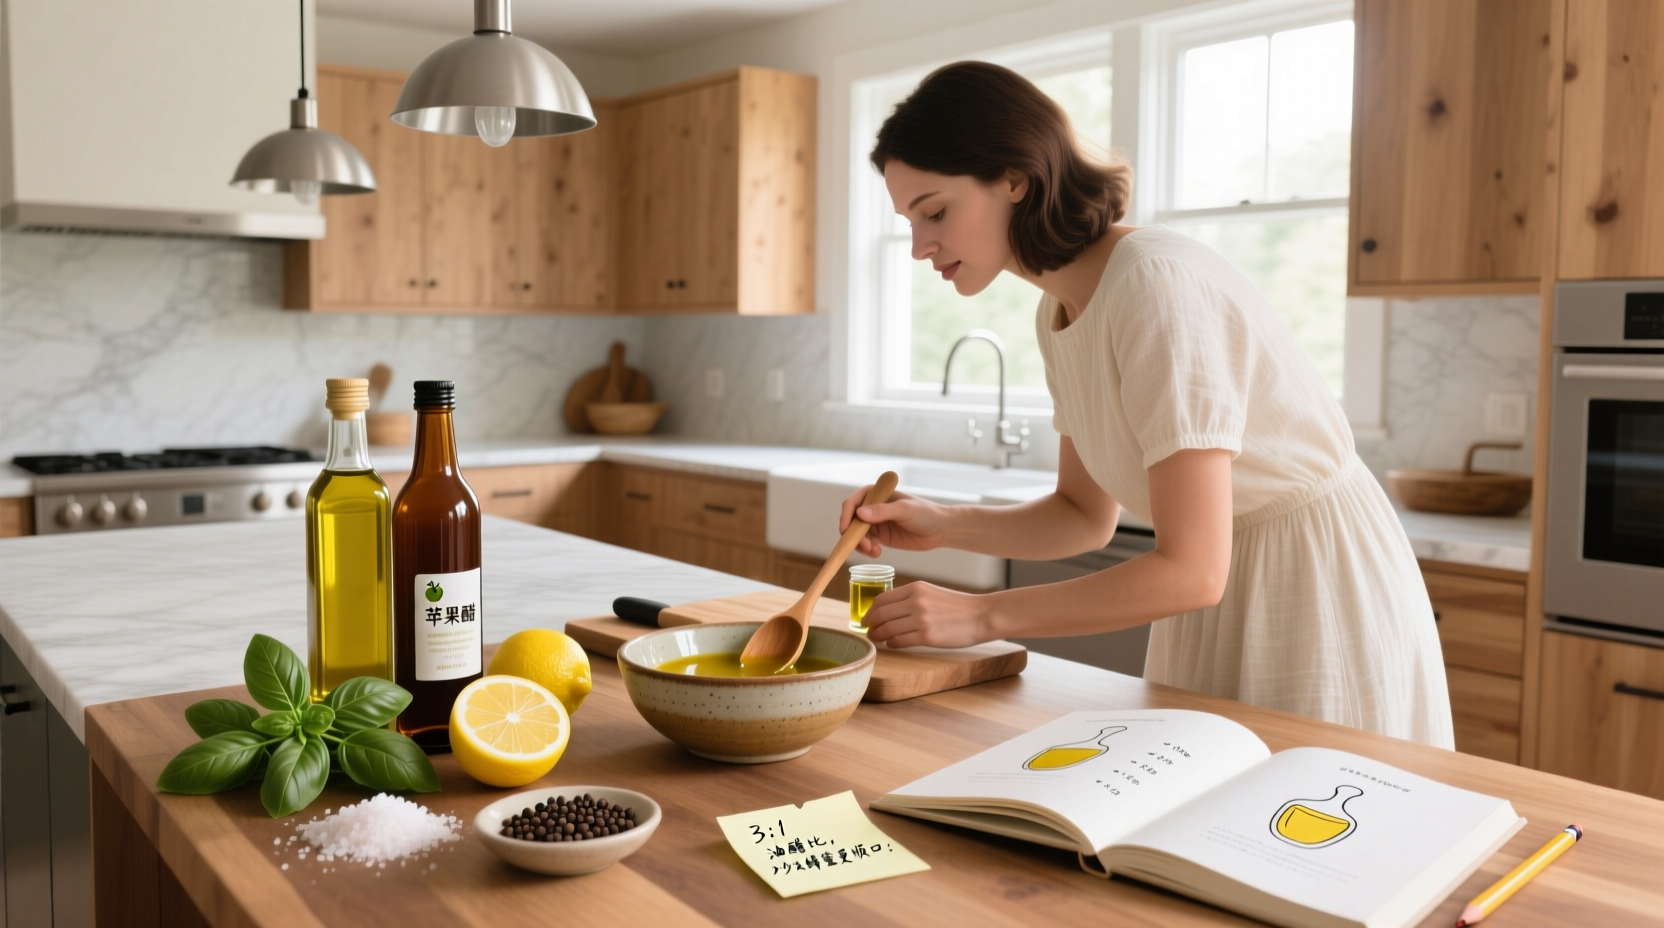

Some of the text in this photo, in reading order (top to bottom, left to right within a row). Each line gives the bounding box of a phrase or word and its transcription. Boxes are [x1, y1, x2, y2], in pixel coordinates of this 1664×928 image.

[425, 602, 475, 627] 苹果醋
[749, 819, 786, 844] 3:1
